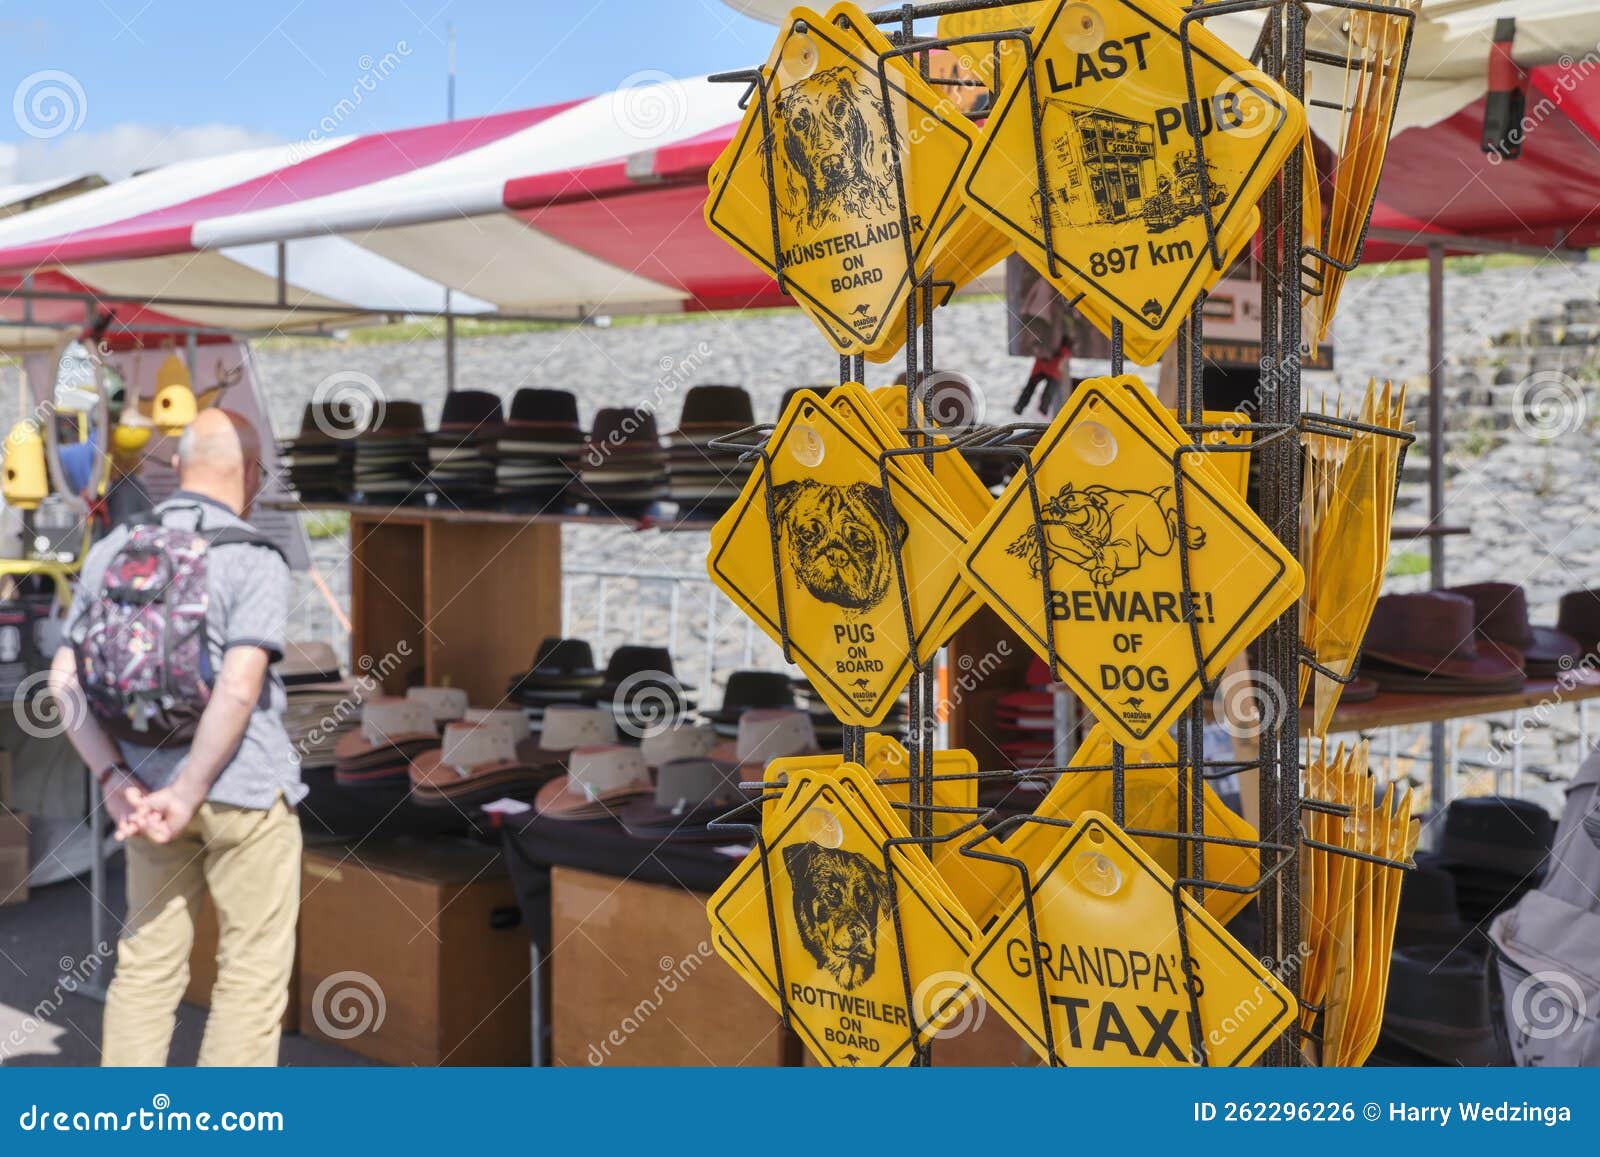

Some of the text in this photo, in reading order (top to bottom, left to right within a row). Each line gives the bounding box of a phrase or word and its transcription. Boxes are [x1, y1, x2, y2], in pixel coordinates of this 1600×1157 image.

[1044, 32, 1152, 93] LAST
[1154, 91, 1243, 146] PUB
[780, 214, 924, 268] MÜNSTERLÄNDR
[842, 254, 865, 271] ON
[1088, 239, 1194, 277] 897 km
[831, 268, 883, 293] BOARD
[1050, 590, 1215, 624] BEWARE!
[833, 623, 875, 645] PUG
[1113, 633, 1143, 653] OF
[847, 646, 868, 659] ON
[836, 660, 884, 674] BOARD
[1100, 664, 1169, 692] DOG
[1006, 938, 1205, 998] GRANDPA'S
[791, 982, 907, 1027] ROTTWEILER
[839, 1016, 862, 1033] ON
[825, 1028, 879, 1052] BOARD
